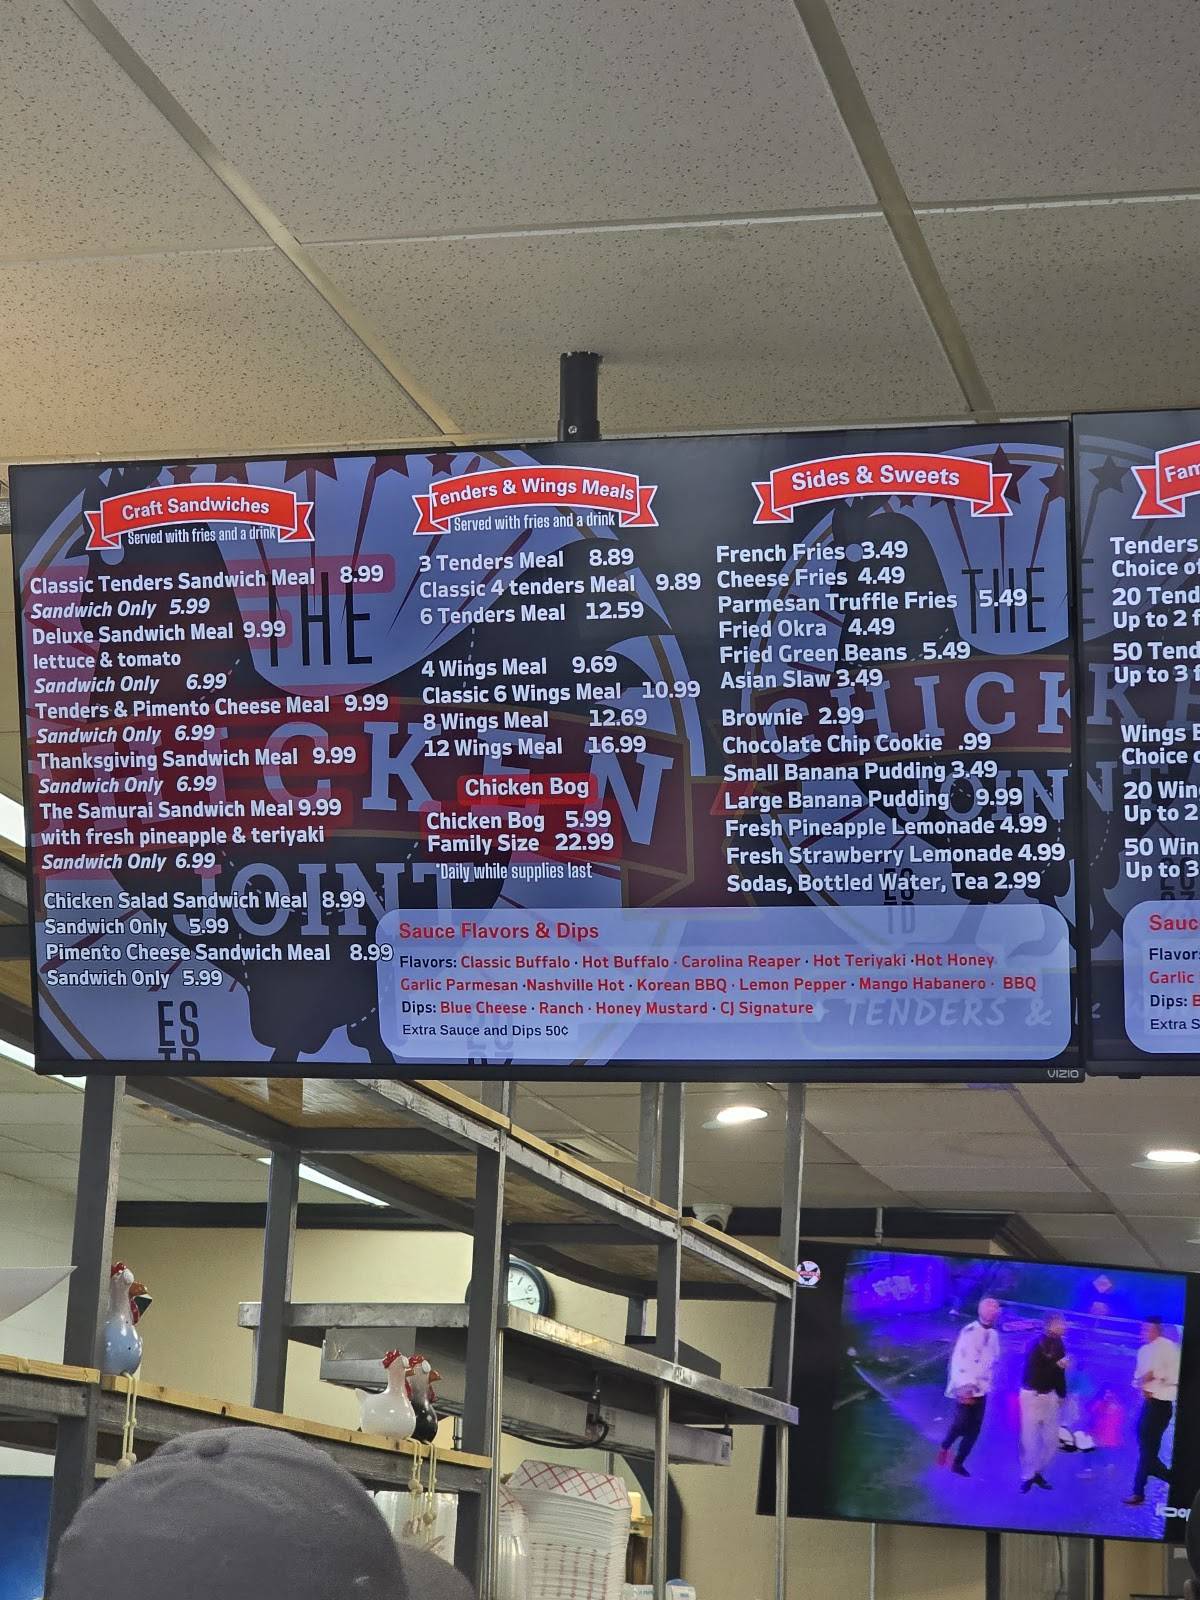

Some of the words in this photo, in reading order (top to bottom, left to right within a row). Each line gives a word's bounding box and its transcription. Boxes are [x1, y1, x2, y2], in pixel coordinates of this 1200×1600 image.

[792, 470, 849, 490] Sides
[857, 466, 873, 483] &
[881, 465, 959, 485] Sweets
[430, 483, 497, 508] Tenders
[503, 480, 516, 494] &
[522, 478, 576, 496] Wings
[583, 479, 633, 500] Meals
[123, 501, 163, 520] Craft
[168, 497, 269, 513] Sandwiches
[454, 516, 492, 531] Served
[495, 515, 520, 529] with
[524, 514, 549, 528] fries
[554, 513, 573, 527] and
[577, 516, 583, 526] a
[587, 512, 615, 526] drink
[128, 530, 162, 545] Served
[166, 529, 189, 543] with
[192, 529, 215, 541] fries
[219, 527, 237, 540] and
[241, 530, 246, 539] a
[249, 525, 276, 540] drink
[1110, 536, 1198, 554] Tenders
[419, 556, 431, 572] 3
[436, 554, 513, 570] Tenders
[520, 551, 563, 568] Meal
[590, 548, 633, 566] 8.89
[717, 545, 786, 562] French
[793, 543, 845, 560] Fries
[862, 541, 907, 559] 3.49
[31, 577, 93, 594] Classic
[98, 575, 173, 591] Tenders
[179, 570, 265, 589] Sandwich
[272, 568, 314, 585] Meal
[341, 565, 383, 583] 8.99
[420, 581, 485, 598] Classic
[491, 580, 504, 595] 4
[509, 578, 584, 595] tenders
[591, 575, 634, 592] Meal
[656, 573, 700, 590] 9.89
[31, 602, 112, 619] Sandwich
[118, 600, 156, 618] Only
[170, 598, 209, 614] 5.99
[719, 596, 819, 613] Parmesan
[826, 592, 898, 610] Truffle
[905, 591, 957, 609] Fries
[980, 589, 1027, 607] 5.49
[33, 628, 93, 644] Deluxe
[99, 624, 184, 642] Sandwich
[191, 623, 232, 639] Meal
[244, 621, 285, 638] 9.99
[720, 621, 771, 638] Fried
[778, 620, 826, 636] Okra
[848, 618, 894, 635] 4.49
[34, 654, 94, 669] lettuce
[100, 652, 112, 667] &
[118, 652, 180, 667] tomato
[720, 646, 772, 663] Fried
[779, 645, 838, 662] Green
[845, 644, 907, 661] Beans
[924, 642, 970, 659] 5.49
[422, 661, 434, 677] 4
[439, 660, 496, 679] Wings
[503, 658, 546, 675] Meal
[573, 656, 617, 673] 9.69
[1115, 667, 1141, 686] Up
[1147, 667, 1168, 682] to
[1175, 665, 1187, 681] 3
[423, 686, 488, 704] Classic
[494, 685, 506, 702] 6
[512, 685, 570, 704] Wings
[577, 683, 620, 699] Meal
[643, 681, 700, 698] 10.99
[35, 703, 109, 719] Tenders
[114, 701, 127, 717] &
[134, 701, 209, 716] Pimento
[215, 698, 280, 715] Cheese
[287, 696, 329, 713] Meal
[345, 694, 388, 711] 9.99
[723, 709, 802, 726] Brownie
[819, 707, 863, 724] 2.99
[723, 736, 821, 753] Chocolate
[828, 735, 870, 755] Chip
[876, 734, 942, 751] Cookie
[959, 733, 990, 750] .99
[1121, 725, 1186, 745] Wings
[425, 740, 449, 756] 12
[455, 740, 512, 759] Wings
[519, 738, 562, 754] Meal
[589, 736, 646, 753] 16.99
[37, 752, 157, 771] Thanksgiving
[163, 750, 249, 767] Sandwich
[256, 748, 297, 765] Meal
[313, 747, 356, 764] 9.99
[466, 779, 543, 796] Chicken
[551, 778, 588, 798] Bog
[40, 804, 72, 819] The
[78, 802, 152, 818] Samurai
[159, 801, 244, 817] Sandwich
[251, 800, 292, 816] Meal
[299, 799, 341, 816] 9.99
[427, 813, 501, 829] Chicken
[509, 812, 544, 832] Bog
[566, 810, 611, 827] 5.99
[41, 829, 80, 844] with
[86, 828, 134, 844] fresh
[140, 827, 226, 847] pineapple
[232, 826, 245, 843] &
[251, 826, 323, 846] teriyaki
[429, 835, 492, 855] Family
[498, 834, 539, 851] Size
[556, 833, 613, 850] 22.99
[727, 847, 782, 864] Fresh
[790, 846, 903, 866] Strawberry
[910, 845, 1013, 862] Lemonade
[1018, 844, 1065, 860] 4.99
[728, 875, 792, 894] Sodas,
[799, 874, 872, 891] Bottled
[879, 874, 945, 892] Water,
[952, 873, 988, 889] Tea
[995, 872, 1040, 888] 2.99
[44, 893, 112, 908] Chicken
[119, 892, 168, 908] Salad
[174, 892, 259, 908] Sandwich
[265, 892, 307, 907] Meal
[323, 891, 365, 908] 8.99
[399, 923, 455, 939] Sauce
[461, 922, 529, 939] Flavors
[535, 922, 550, 939] &
[556, 922, 599, 942] Dips
[47, 944, 121, 959] Pimento
[127, 944, 190, 960] Cheese
[196, 944, 281, 960] Sandwich
[288, 944, 330, 960] Meal
[351, 944, 392, 960] 8.99
[402, 1002, 436, 1014] Dips:
[440, 1002, 472, 1014] Blue
[476, 1002, 527, 1014] Cheese
[539, 1002, 584, 1014] Ranch
[596, 1002, 642, 1016] Honey
[646, 1002, 707, 1014] Mustard
[720, 1002, 734, 1016] CJ
[739, 1002, 814, 1016] Signature
[1150, 996, 1187, 1009] Dips:
[402, 1025, 436, 1036] Extra
[440, 1025, 480, 1036] Sauce
[484, 1025, 507, 1036] and
[512, 1025, 542, 1039] Dips
[545, 1025, 569, 1036] 50¢
[1150, 1018, 1187, 1030] Extra
[1048, 1069, 1079, 1079] VIZIO
